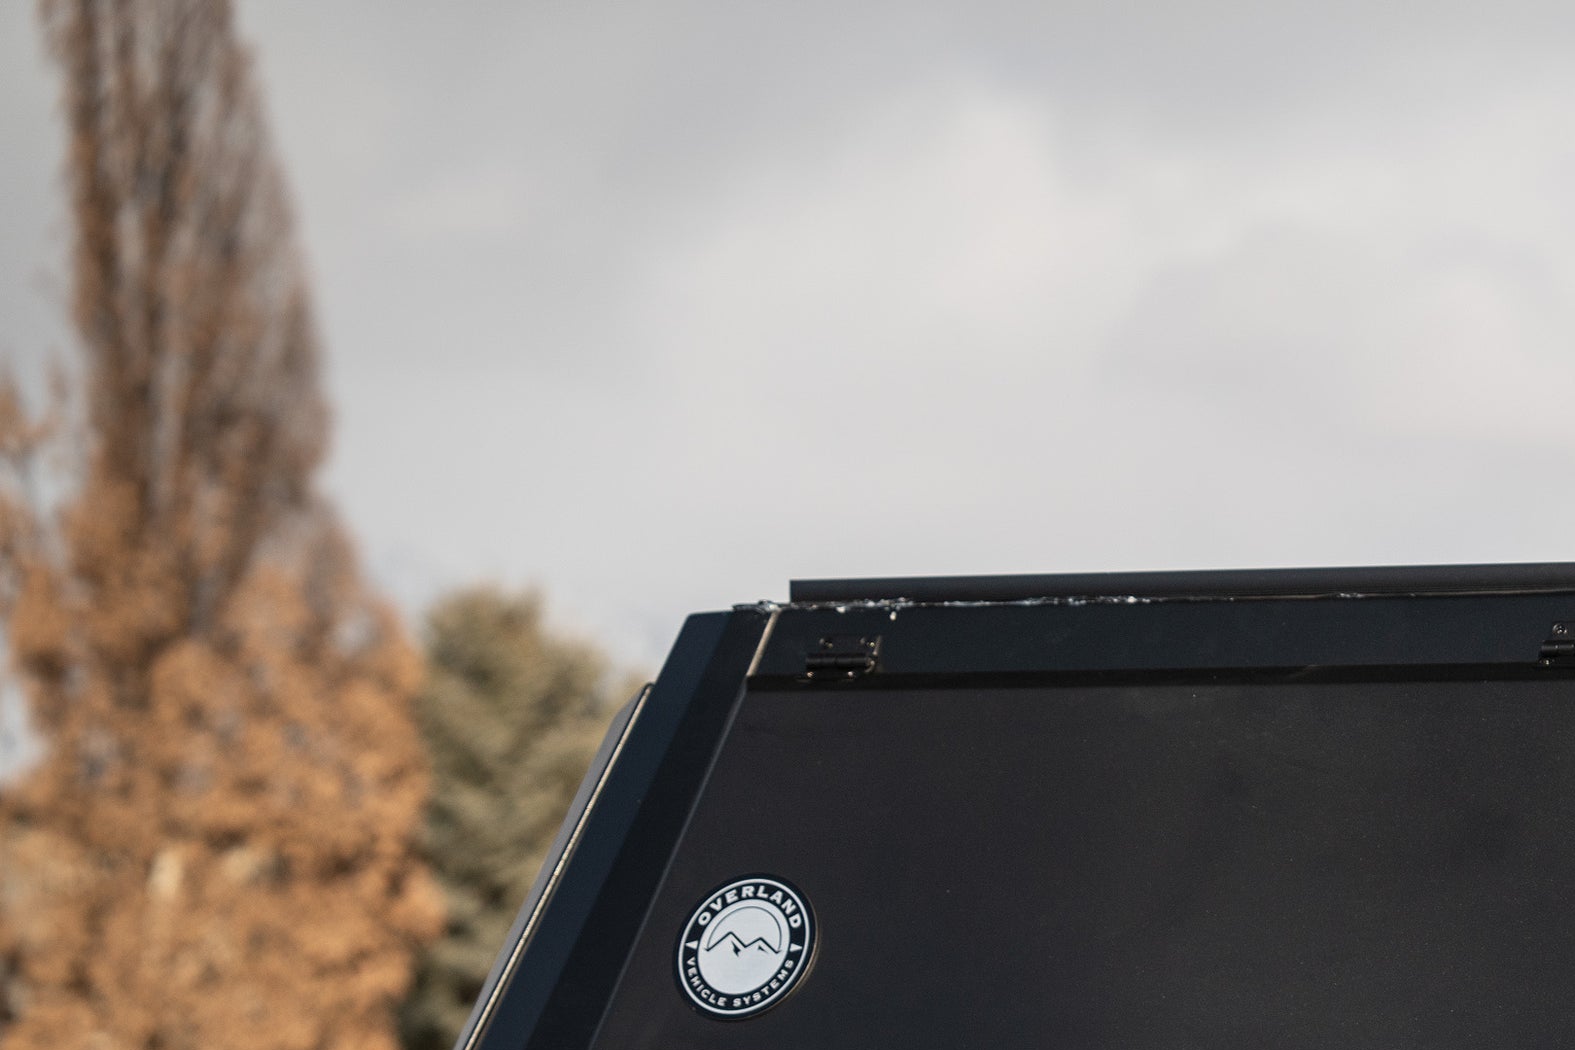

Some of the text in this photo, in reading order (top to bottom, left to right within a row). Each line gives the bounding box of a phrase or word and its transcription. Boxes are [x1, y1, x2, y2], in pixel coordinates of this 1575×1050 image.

[698, 885, 801, 928] OVERLAND
[686, 957, 794, 1007] VEHICLE SYSTEMS
